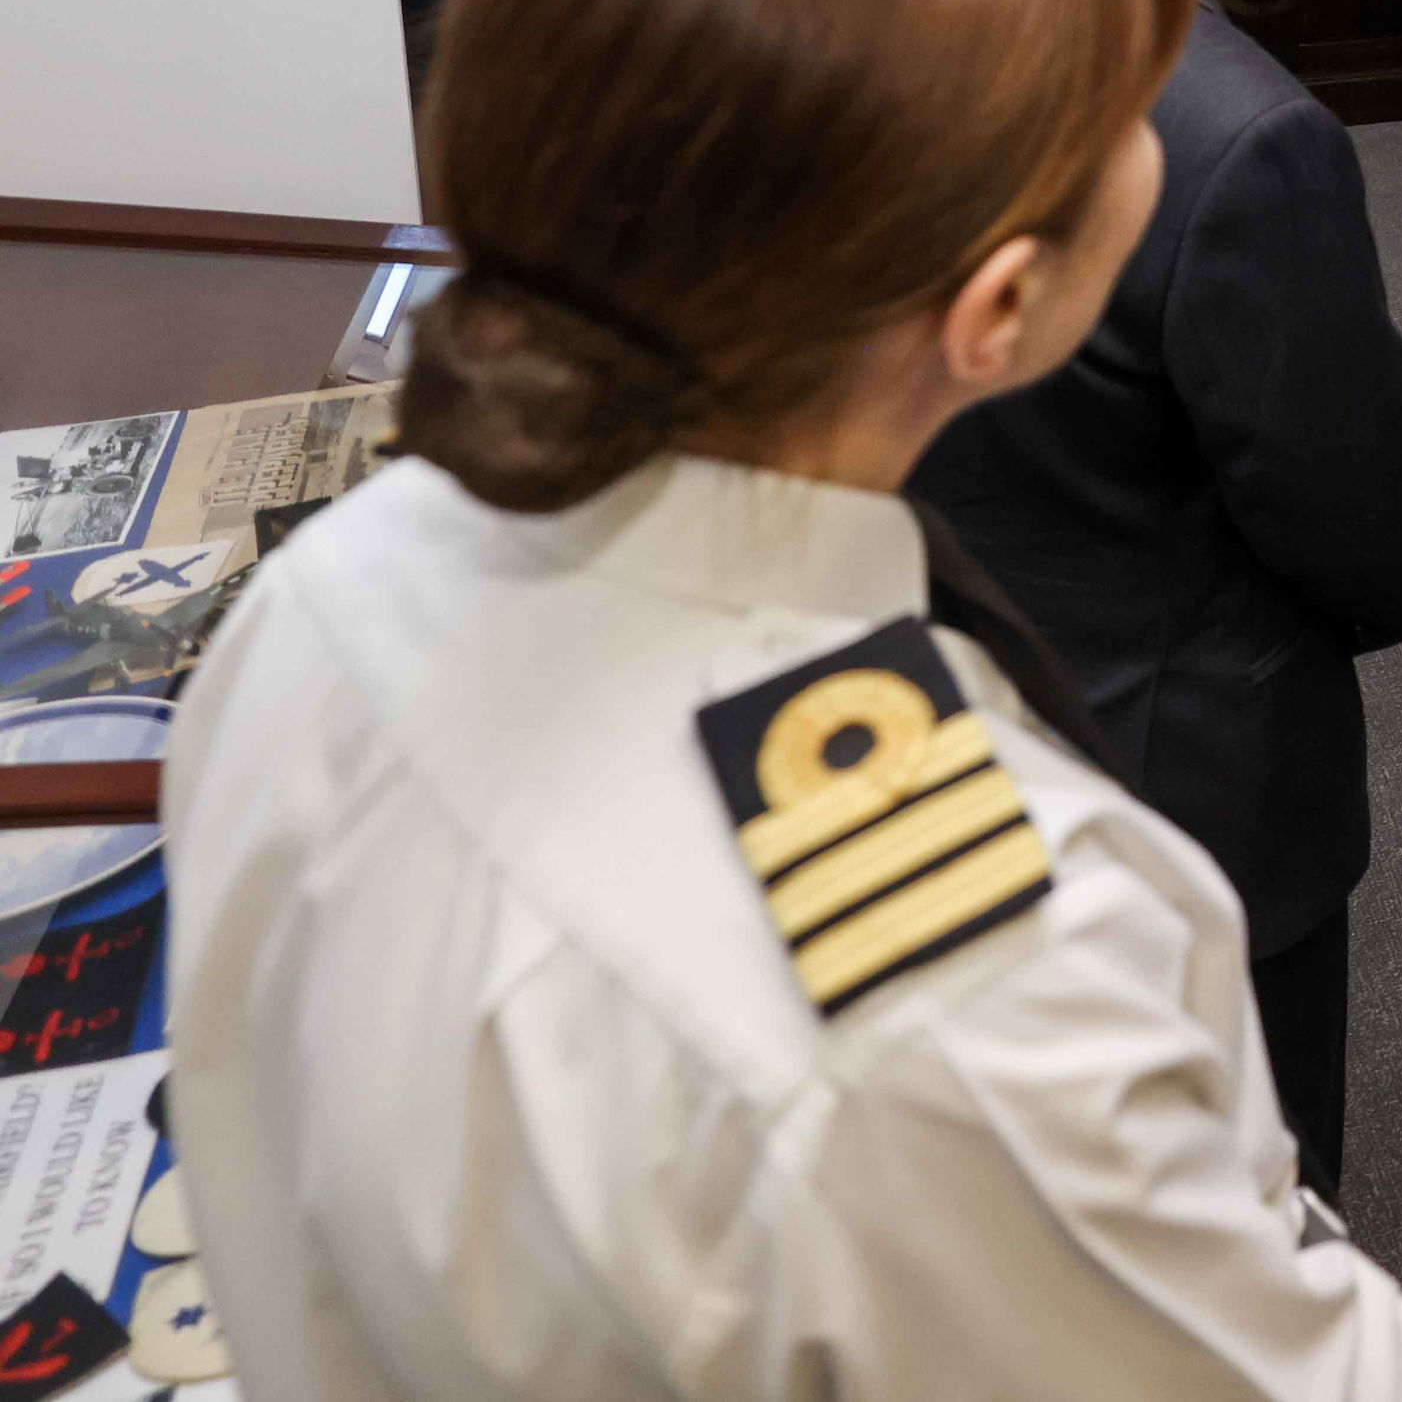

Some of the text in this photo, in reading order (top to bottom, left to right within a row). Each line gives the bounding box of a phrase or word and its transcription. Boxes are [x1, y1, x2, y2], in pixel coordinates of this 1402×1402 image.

[28, 1131, 83, 1223] WOULD
[60, 1076, 102, 1128] LIKE
[88, 1120, 134, 1194] KNOW
